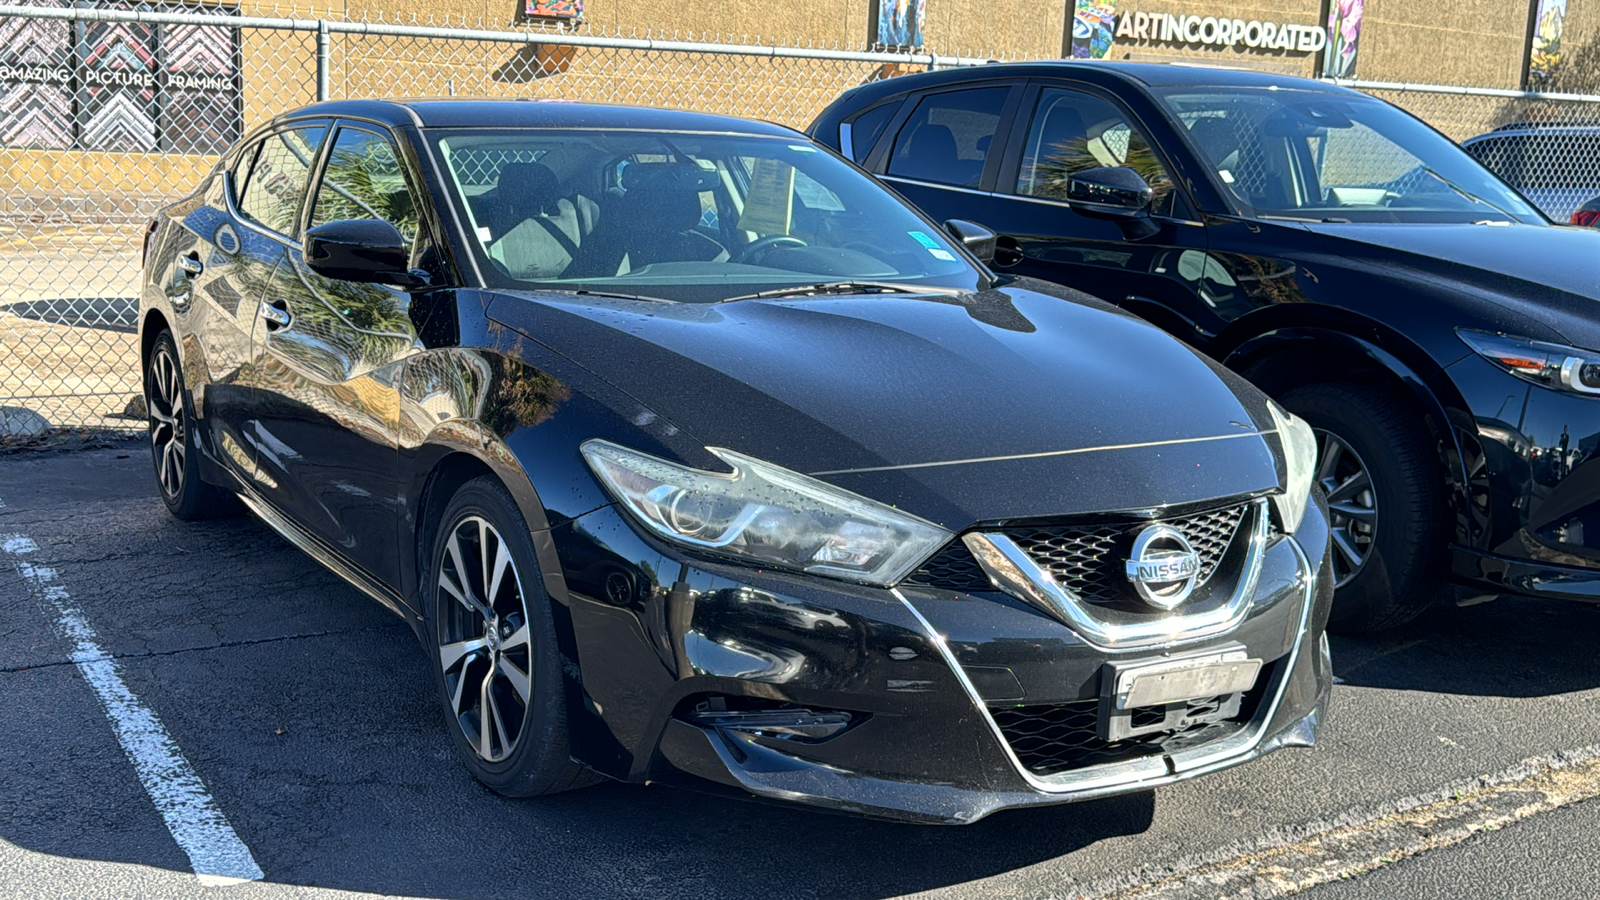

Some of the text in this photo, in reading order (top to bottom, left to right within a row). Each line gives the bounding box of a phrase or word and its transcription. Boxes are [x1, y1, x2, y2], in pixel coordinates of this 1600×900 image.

[1116, 10, 1326, 52] ARTINCORPORATED
[86, 71, 153, 86] PICTURE
[168, 75, 232, 90] FRAMING
[1139, 556, 1198, 579] NISSAN
